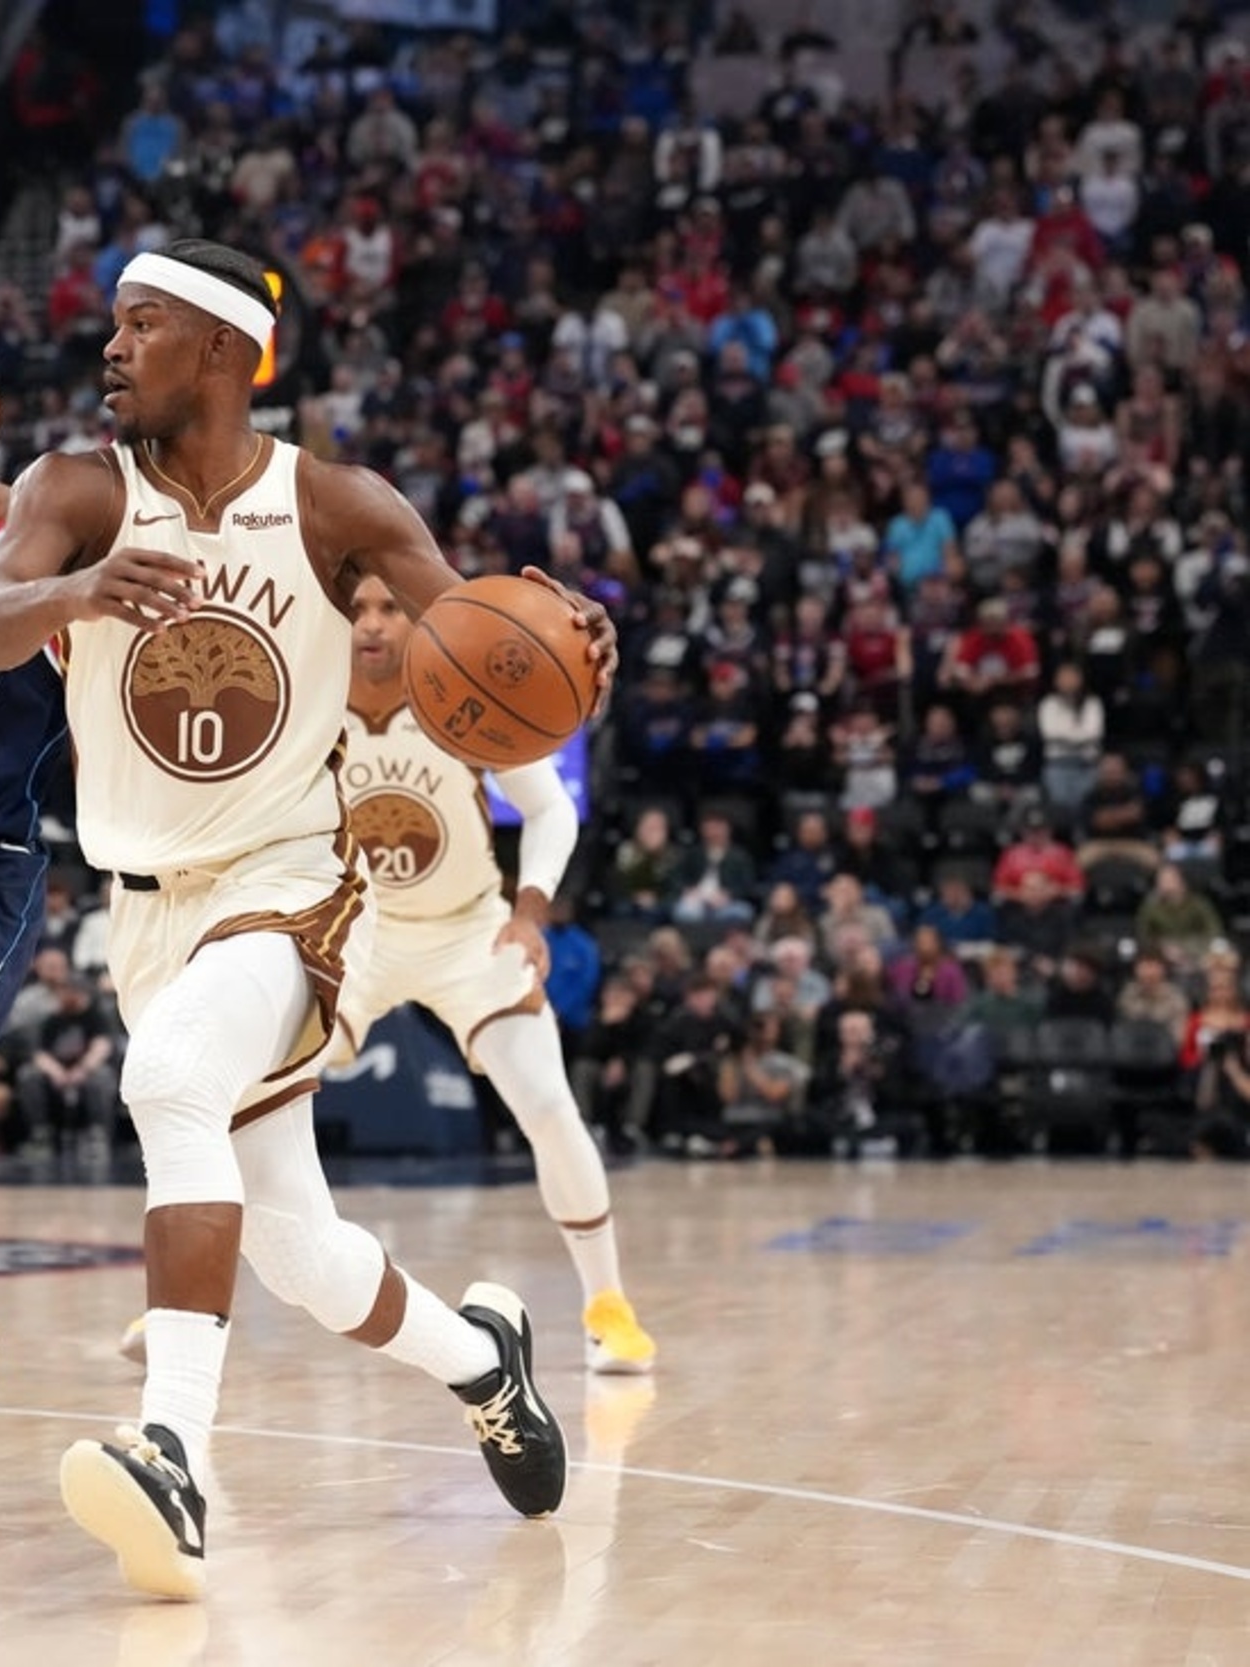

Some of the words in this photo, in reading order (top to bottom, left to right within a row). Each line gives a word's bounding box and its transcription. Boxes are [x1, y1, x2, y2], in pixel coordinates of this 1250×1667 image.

[232, 511, 293, 530] Rakuten
[196, 559, 296, 629] WN
[178, 710, 224, 764] 10
[346, 755, 443, 796] OWN
[371, 845, 416, 880] 20
